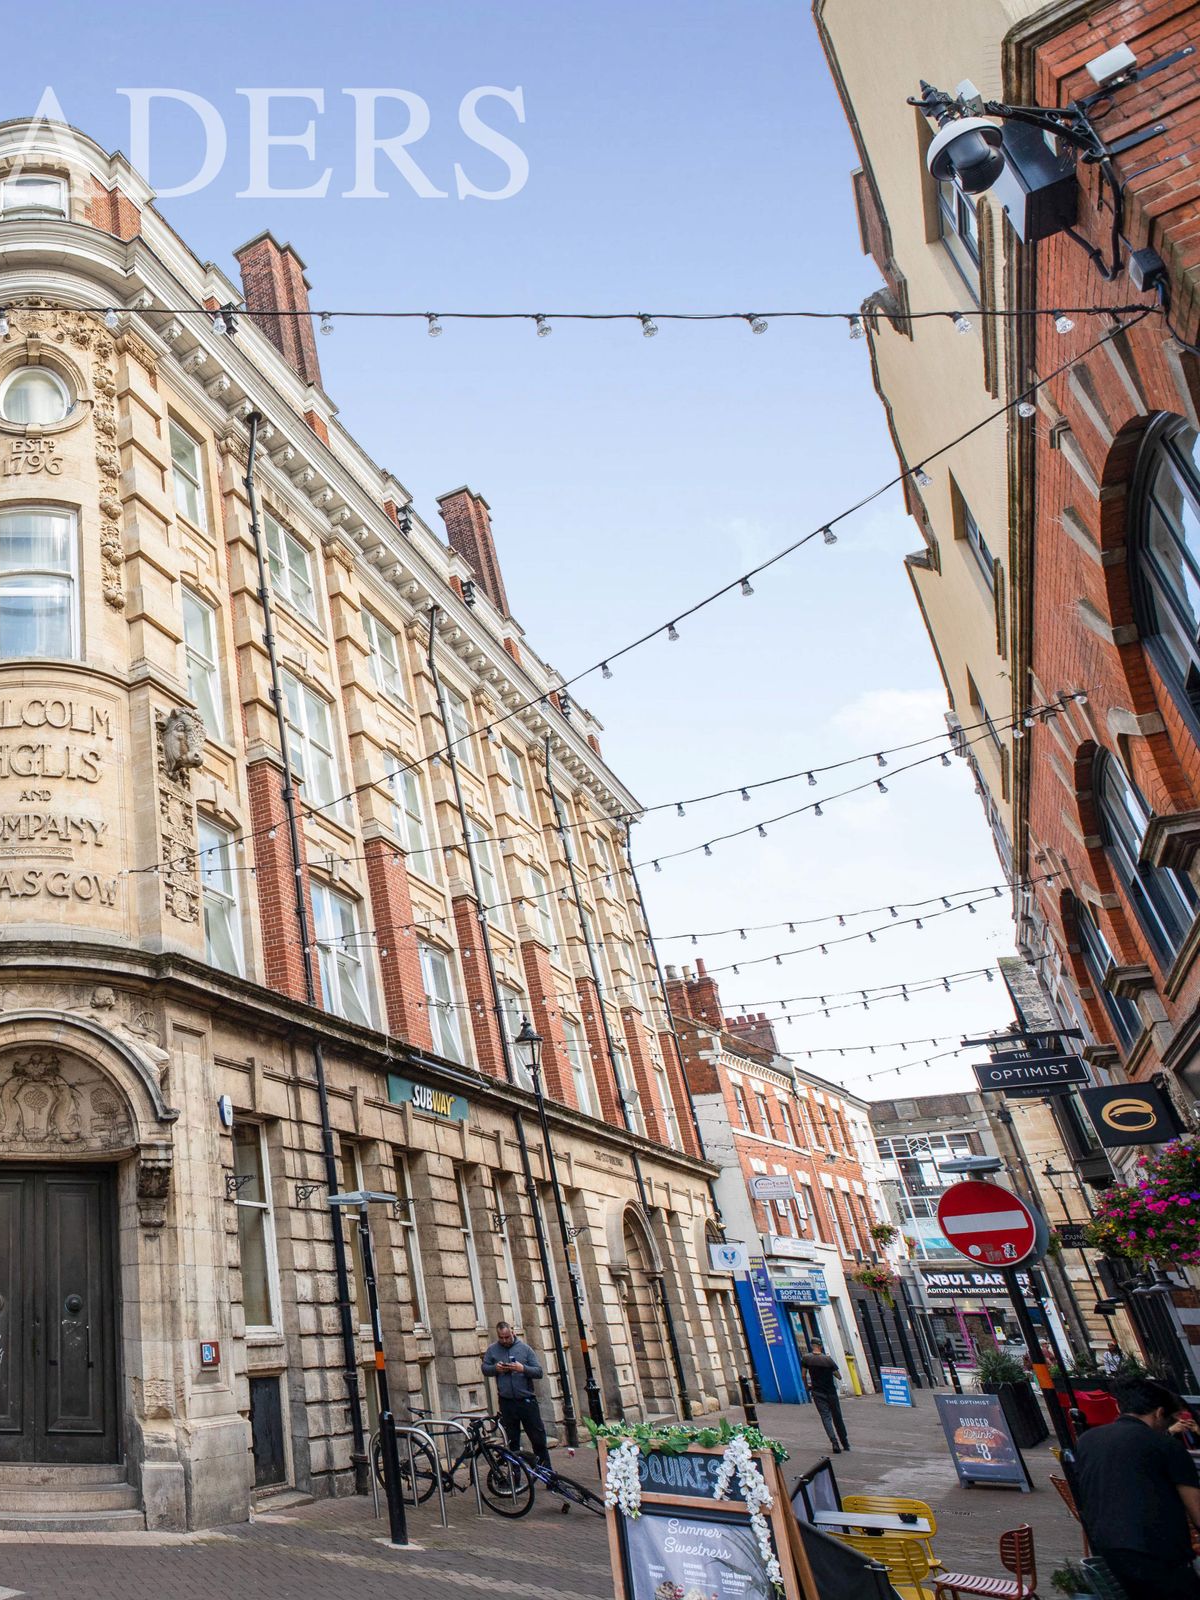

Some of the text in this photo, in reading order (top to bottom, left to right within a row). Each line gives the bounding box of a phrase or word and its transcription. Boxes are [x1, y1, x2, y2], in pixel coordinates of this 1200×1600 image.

[3, 455, 64, 477] 1796
[19, 789, 52, 802] AND
[1013, 1052, 1032, 1060] THE
[990, 1064, 1069, 1081] OPTIMIST
[412, 1085, 455, 1117] SUBWAY
[959, 1417, 990, 1428] BURGER
[963, 1429, 995, 1440] Drink
[667, 1518, 722, 1539] Summer
[664, 1537, 732, 1560] Sweetness
